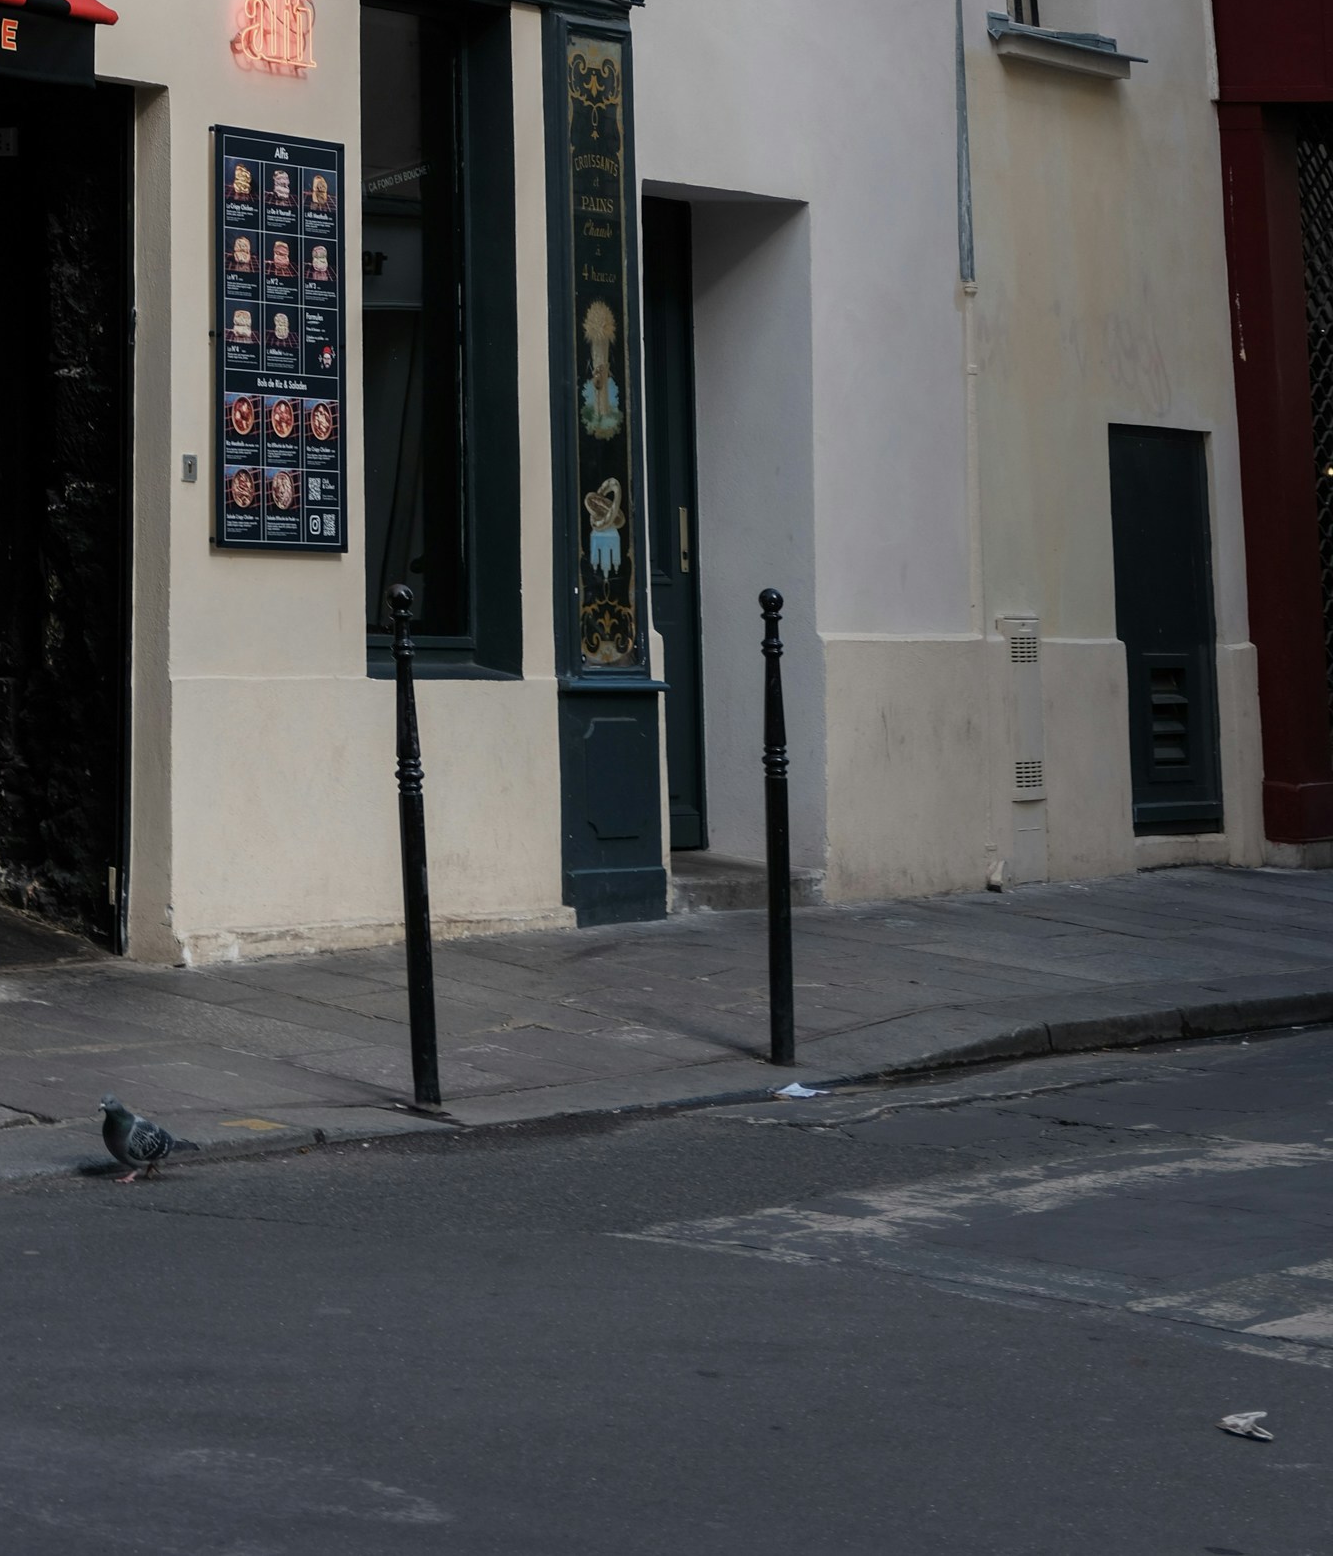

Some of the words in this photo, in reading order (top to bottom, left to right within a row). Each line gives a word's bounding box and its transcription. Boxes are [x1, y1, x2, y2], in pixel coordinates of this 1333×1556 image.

[274, 147, 289, 160] Alfis
[574, 154, 618, 177] CROISSANTS
[377, 176, 394, 189] FOND
[394, 173, 403, 184] EN
[403, 165, 427, 181] BOUCHE
[581, 196, 613, 213] PAINS
[582, 263, 589, 280] 4
[591, 265, 616, 282] heures
[257, 378, 267, 387] Bols
[268, 379, 274, 388] de
[284, 381, 288, 389] &
[289, 381, 307, 390] Salades
